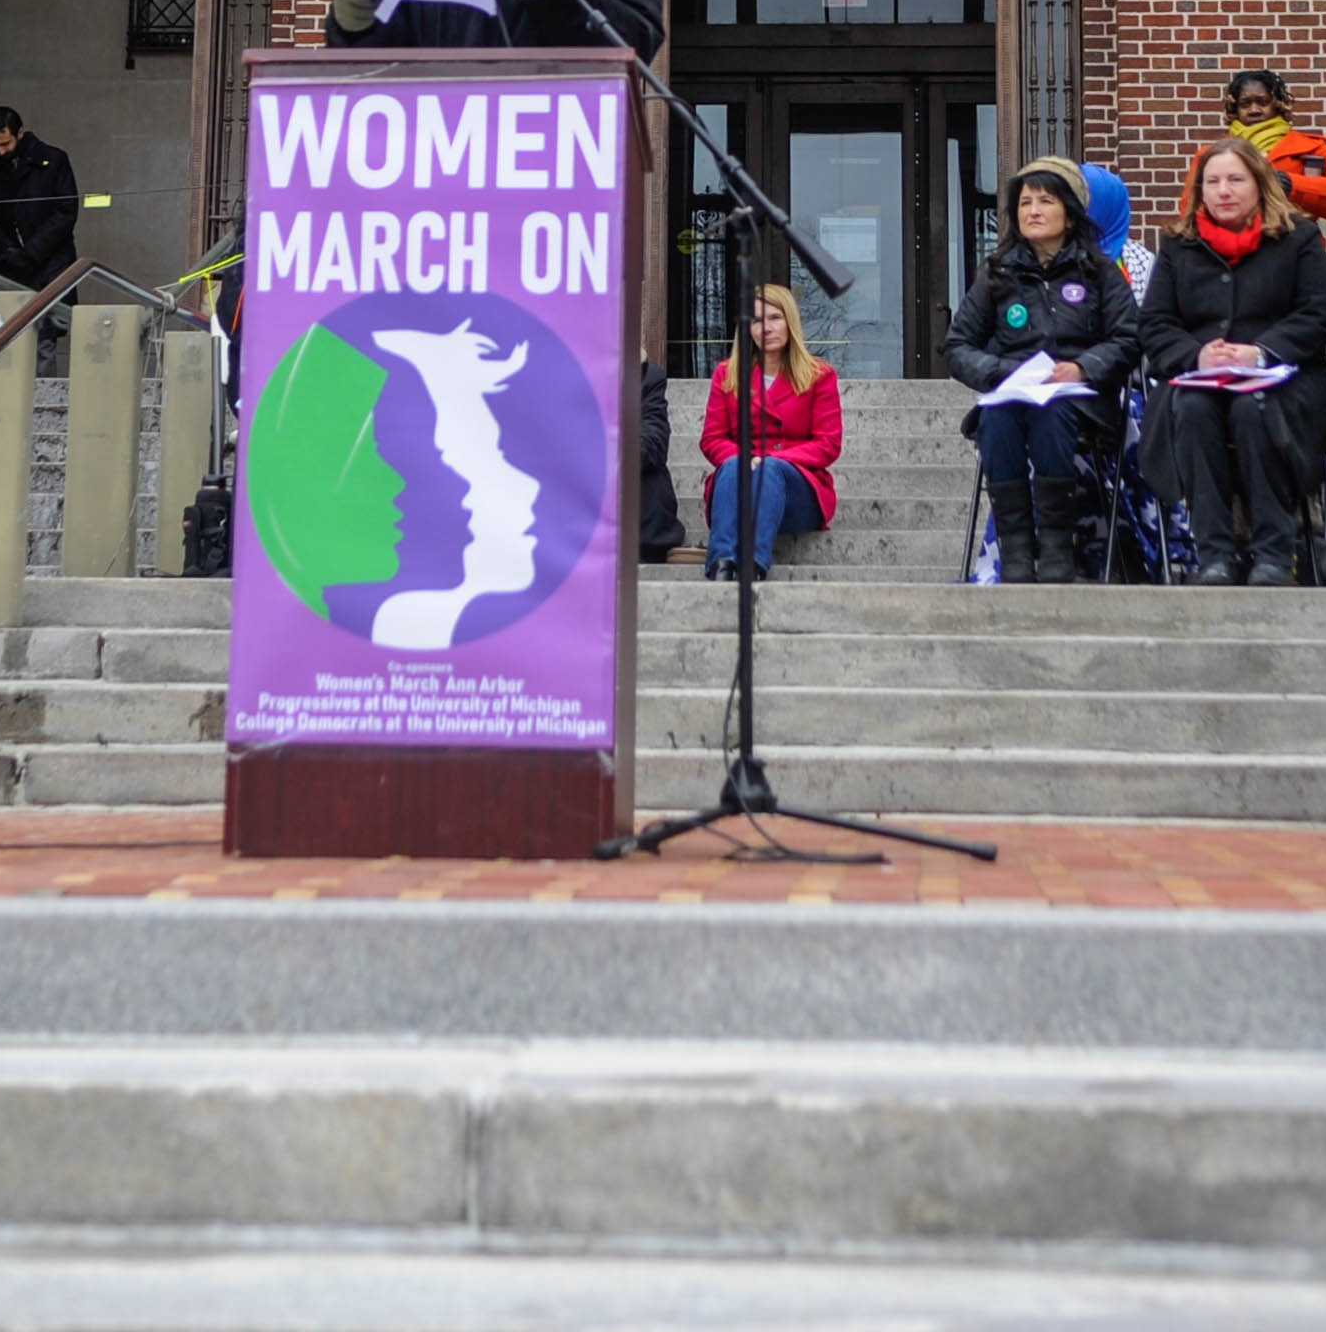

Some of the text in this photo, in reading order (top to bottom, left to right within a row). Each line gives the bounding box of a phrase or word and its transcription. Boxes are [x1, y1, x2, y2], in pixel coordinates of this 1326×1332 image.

[258, 94, 618, 190] WOMEN
[256, 211, 609, 295] MARCH ON
[316, 673, 525, 694] Women's March Ann Arbor
[258, 692, 582, 718] Progressives at the University of Michigan
[235, 712, 607, 740] College Democrats at the University of Michigan
